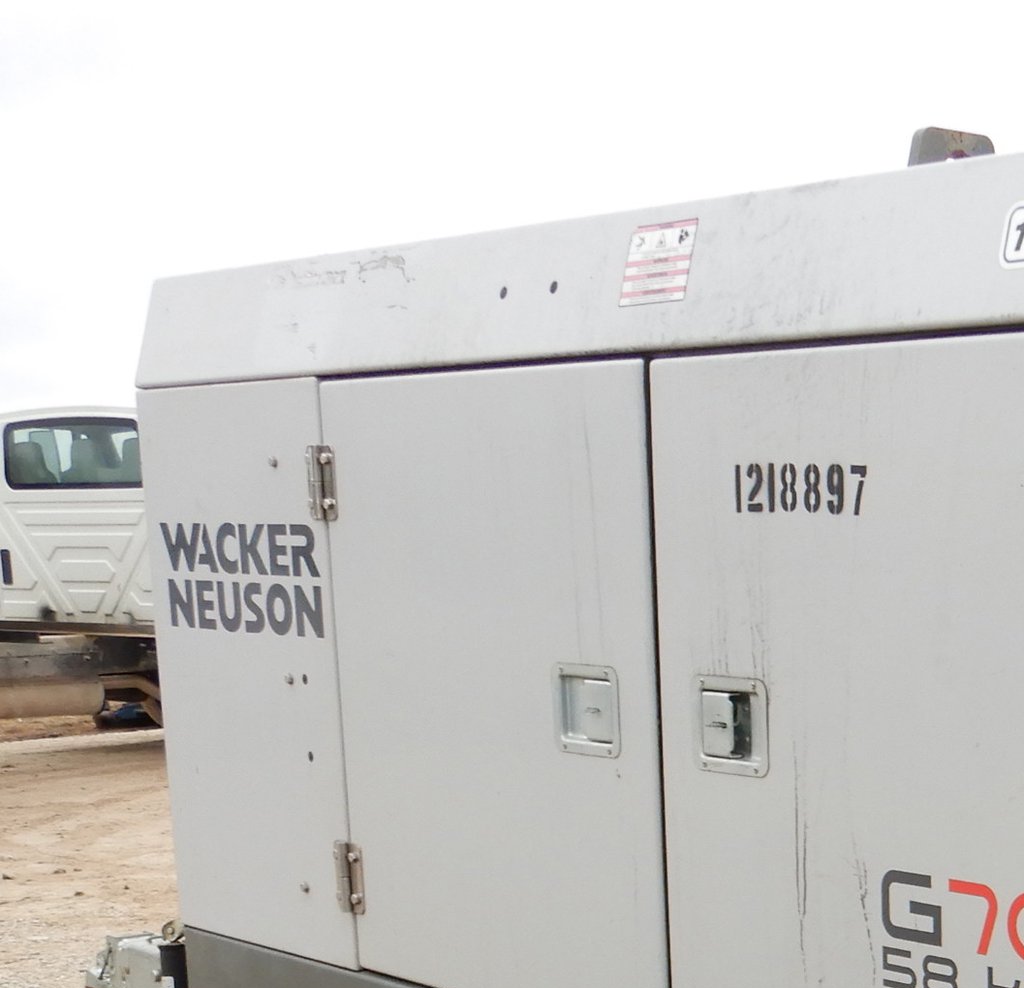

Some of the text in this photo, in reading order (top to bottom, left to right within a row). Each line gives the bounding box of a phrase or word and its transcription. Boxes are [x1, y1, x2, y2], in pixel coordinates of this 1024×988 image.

[735, 463, 867, 516] 1218897
[159, 522, 320, 577] WACKER
[168, 578, 325, 638] NEUSON
